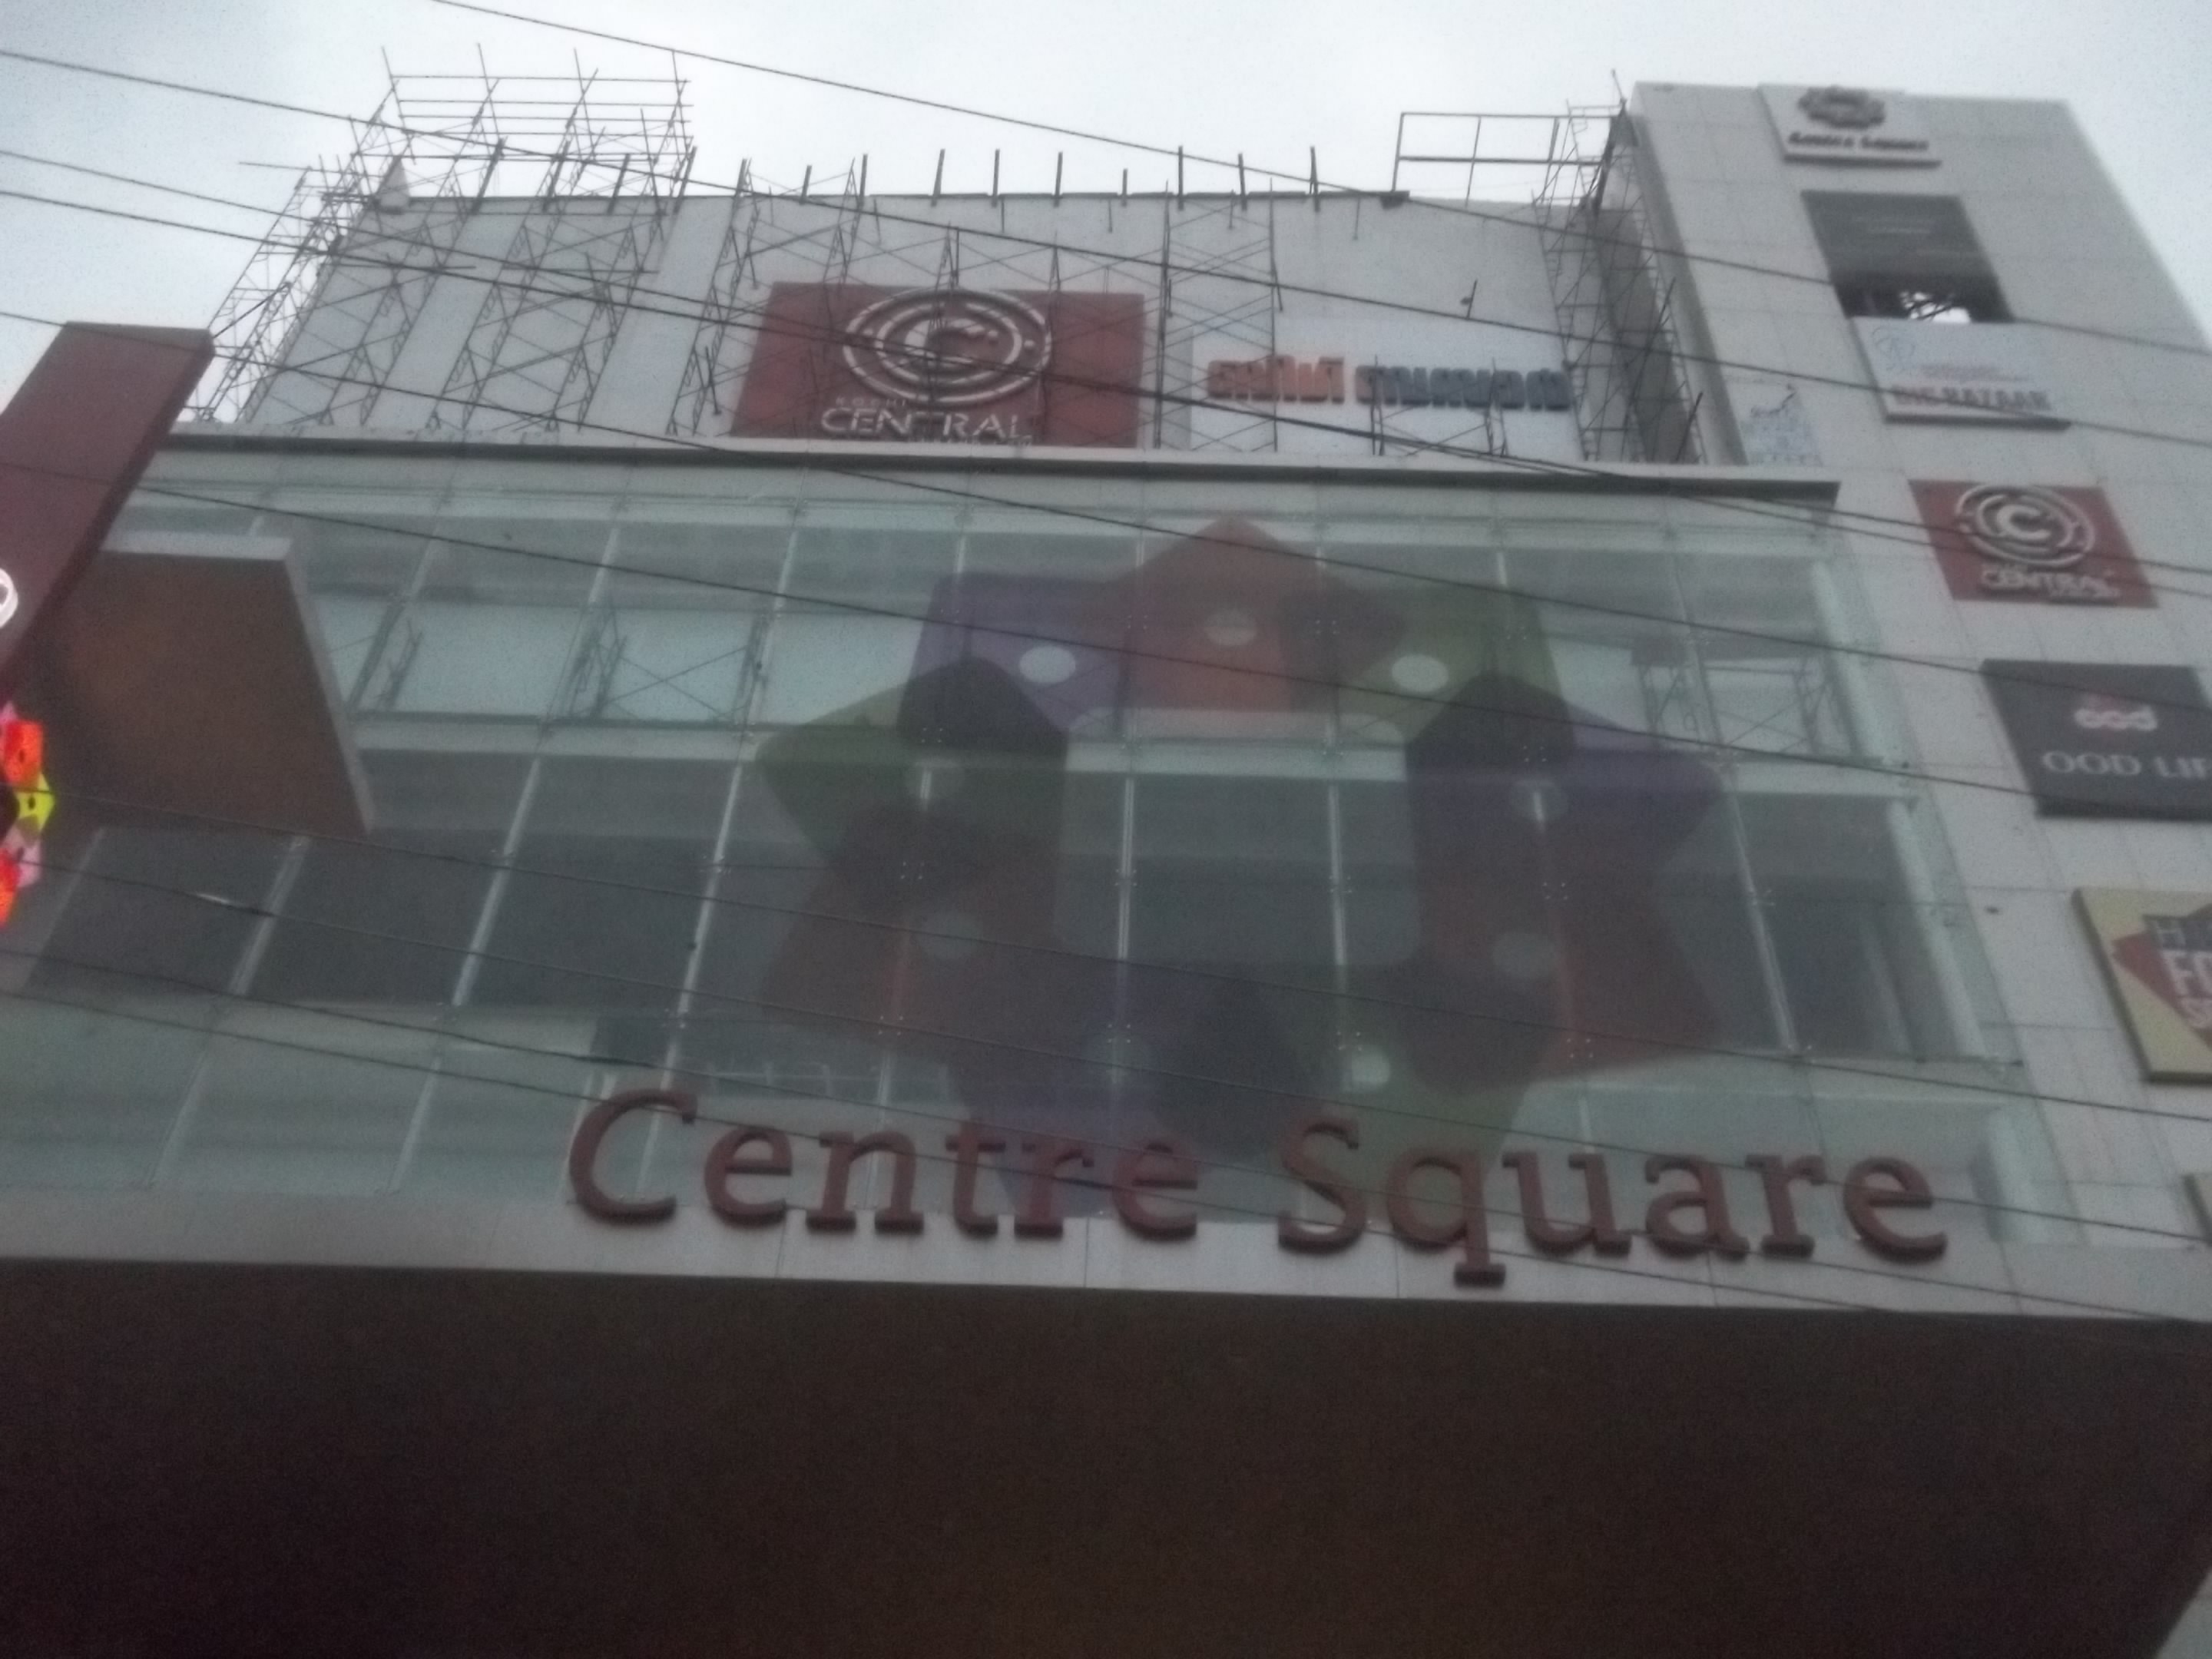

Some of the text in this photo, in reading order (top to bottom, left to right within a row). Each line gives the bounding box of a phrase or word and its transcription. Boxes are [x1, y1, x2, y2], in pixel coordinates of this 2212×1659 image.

[822, 406, 1034, 439] CENTRAL
[568, 1088, 1949, 1288] Centre Square
